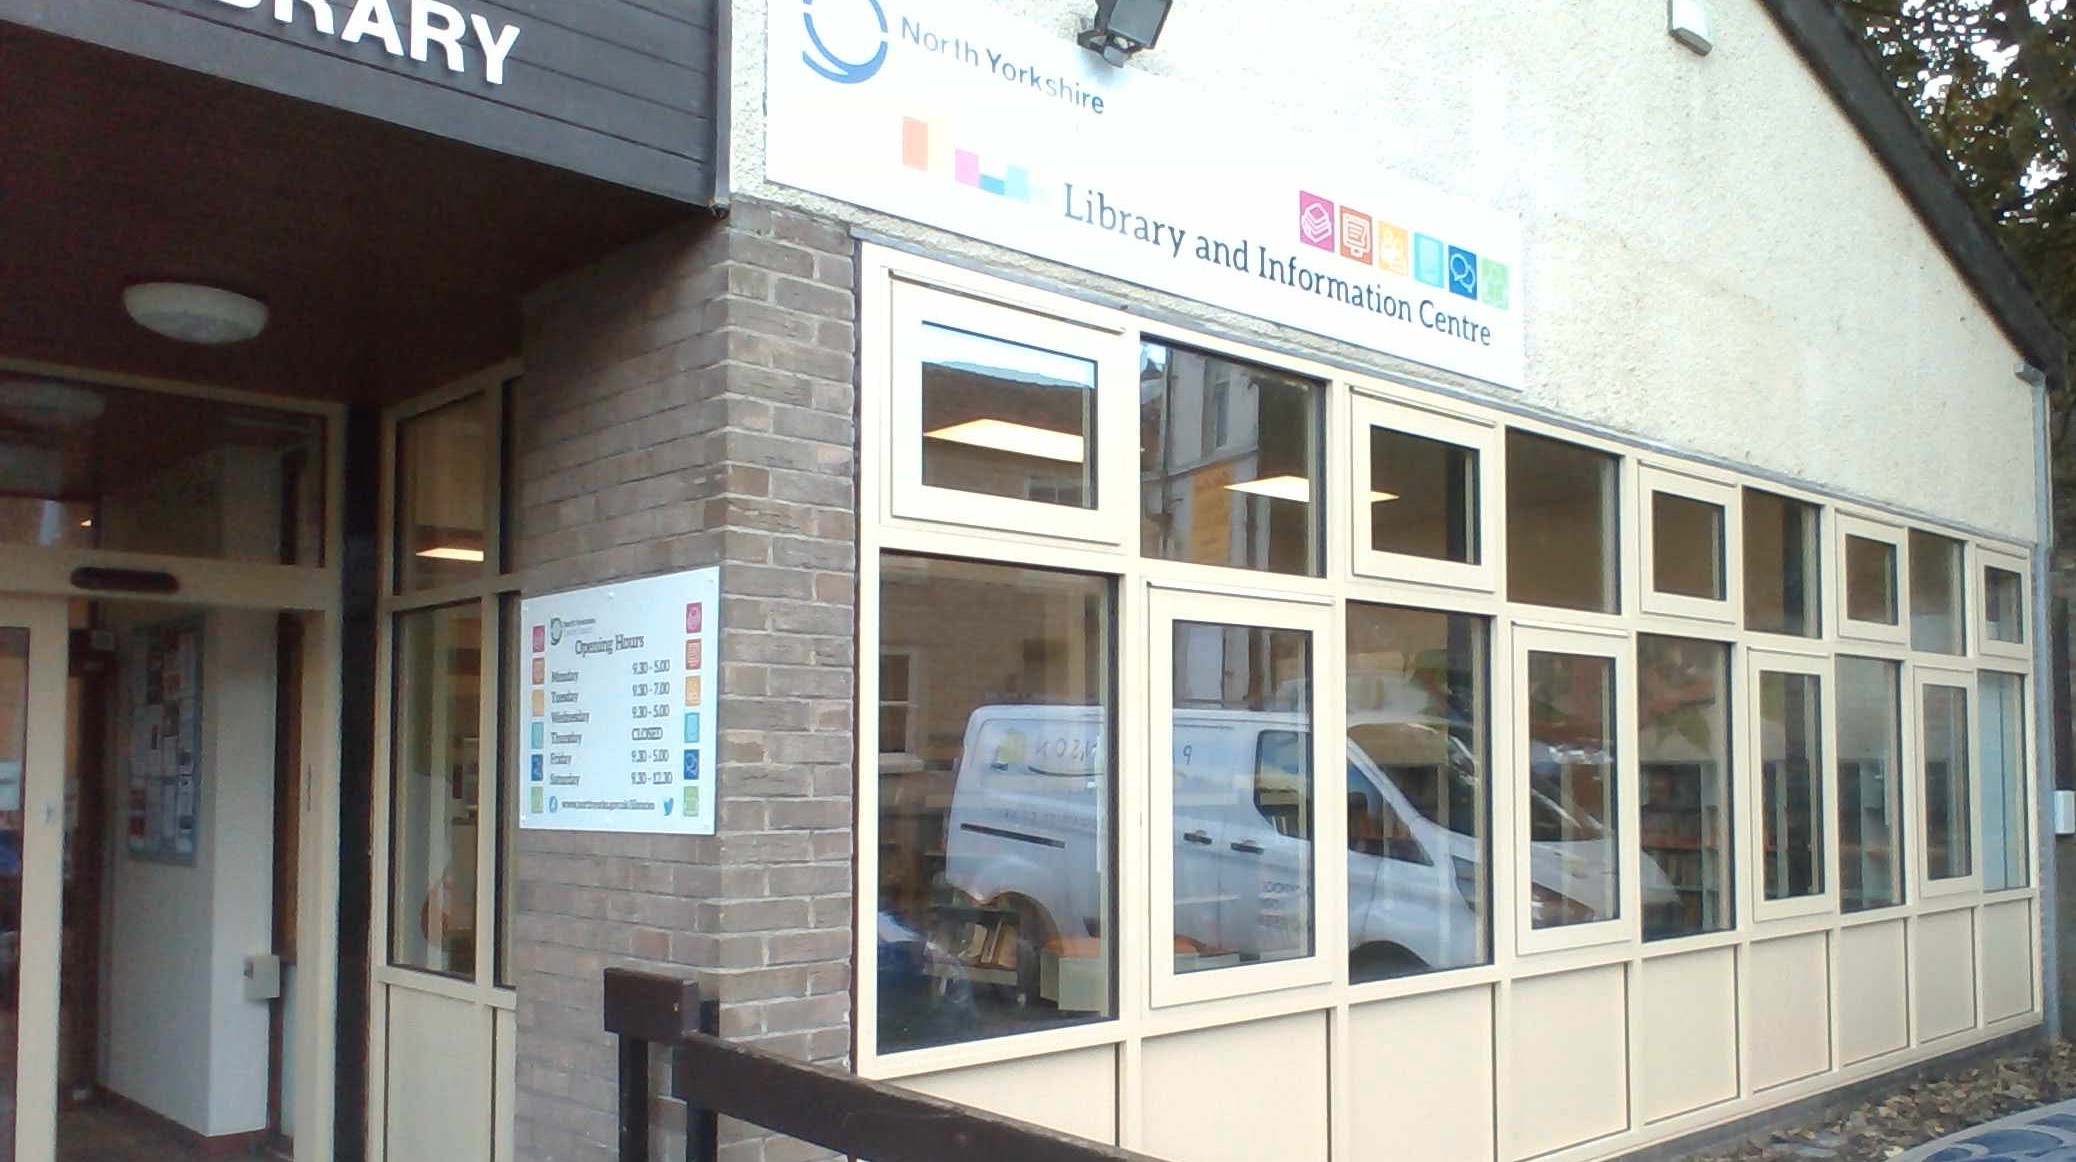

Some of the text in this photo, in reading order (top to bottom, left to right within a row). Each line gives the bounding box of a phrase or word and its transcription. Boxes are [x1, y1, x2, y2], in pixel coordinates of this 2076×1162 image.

[216, 0, 520, 85] ARY
[902, 16, 1105, 114] North Yorkshire
[1064, 183, 1491, 346] Library and Information Centre
[575, 634, 645, 658] Opening Hours
[632, 727, 663, 741] CLOSED
